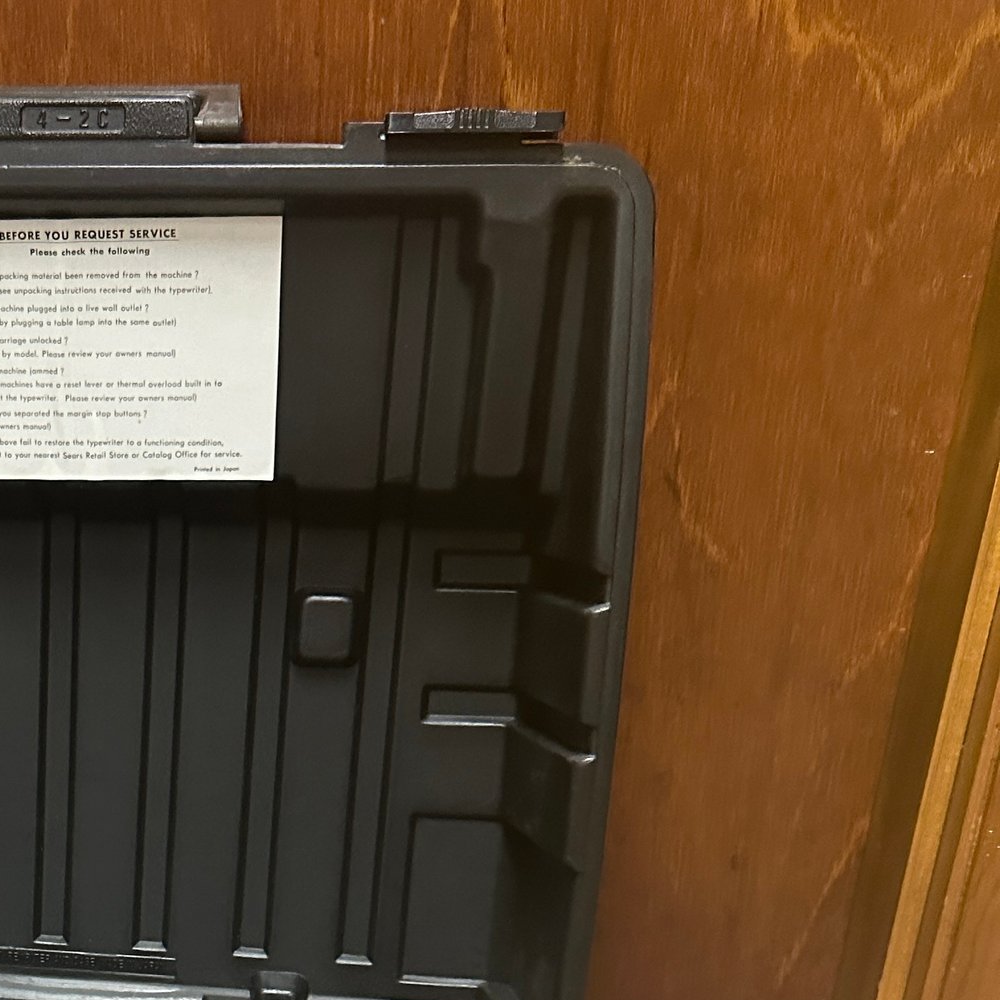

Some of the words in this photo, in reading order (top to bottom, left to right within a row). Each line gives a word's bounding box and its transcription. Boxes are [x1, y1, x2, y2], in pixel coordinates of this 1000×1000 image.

[0, 231, 40, 240] BEFORE
[45, 230, 69, 240] YOU
[75, 230, 124, 239] REQUEST
[130, 230, 176, 238] SERVICE
[30, 248, 57, 256] Please
[62, 248, 85, 256] check
[90, 247, 104, 255] the
[108, 247, 150, 256] following
[0, 272, 28, 281] packing
[86, 271, 119, 279] removed
[146, 271, 157, 279] the
[14, 286, 52, 296] unpacking
[55, 286, 96, 294] instructions
[100, 286, 131, 294] received
[136, 286, 151, 294] with
[27, 304, 57, 314] plugged
[86, 304, 99, 312] live
[102, 304, 117, 312] wall
[121, 304, 142, 312] outlet
[11, 318, 43, 328] plugging
[54, 318, 73, 326] table
[76, 318, 95, 327] lamp
[98, 318, 112, 326] into
[29, 336, 62, 344] unlocked
[42, 350, 65, 358] Please
[30, 367, 58, 376] jammed
[0, 380, 33, 388] machines
[36, 380, 53, 388] have
[85, 380, 102, 388] lever
[117, 380, 145, 388] thermal
[148, 380, 182, 388] overload
[185, 380, 201, 388] built
[65, 394, 89, 402] Please
[14, 409, 50, 418] separated
[67, 410, 92, 419] margin
[96, 410, 111, 419] stop
[114, 409, 141, 418] buttons
[87, 438, 123, 447] typewriter
[144, 438, 185, 448] functioning
[86, 451, 106, 459] Retail
[109, 451, 128, 459] Store
[142, 451, 172, 460] Catalog
[175, 450, 197, 458] Office
[201, 450, 211, 458] for
